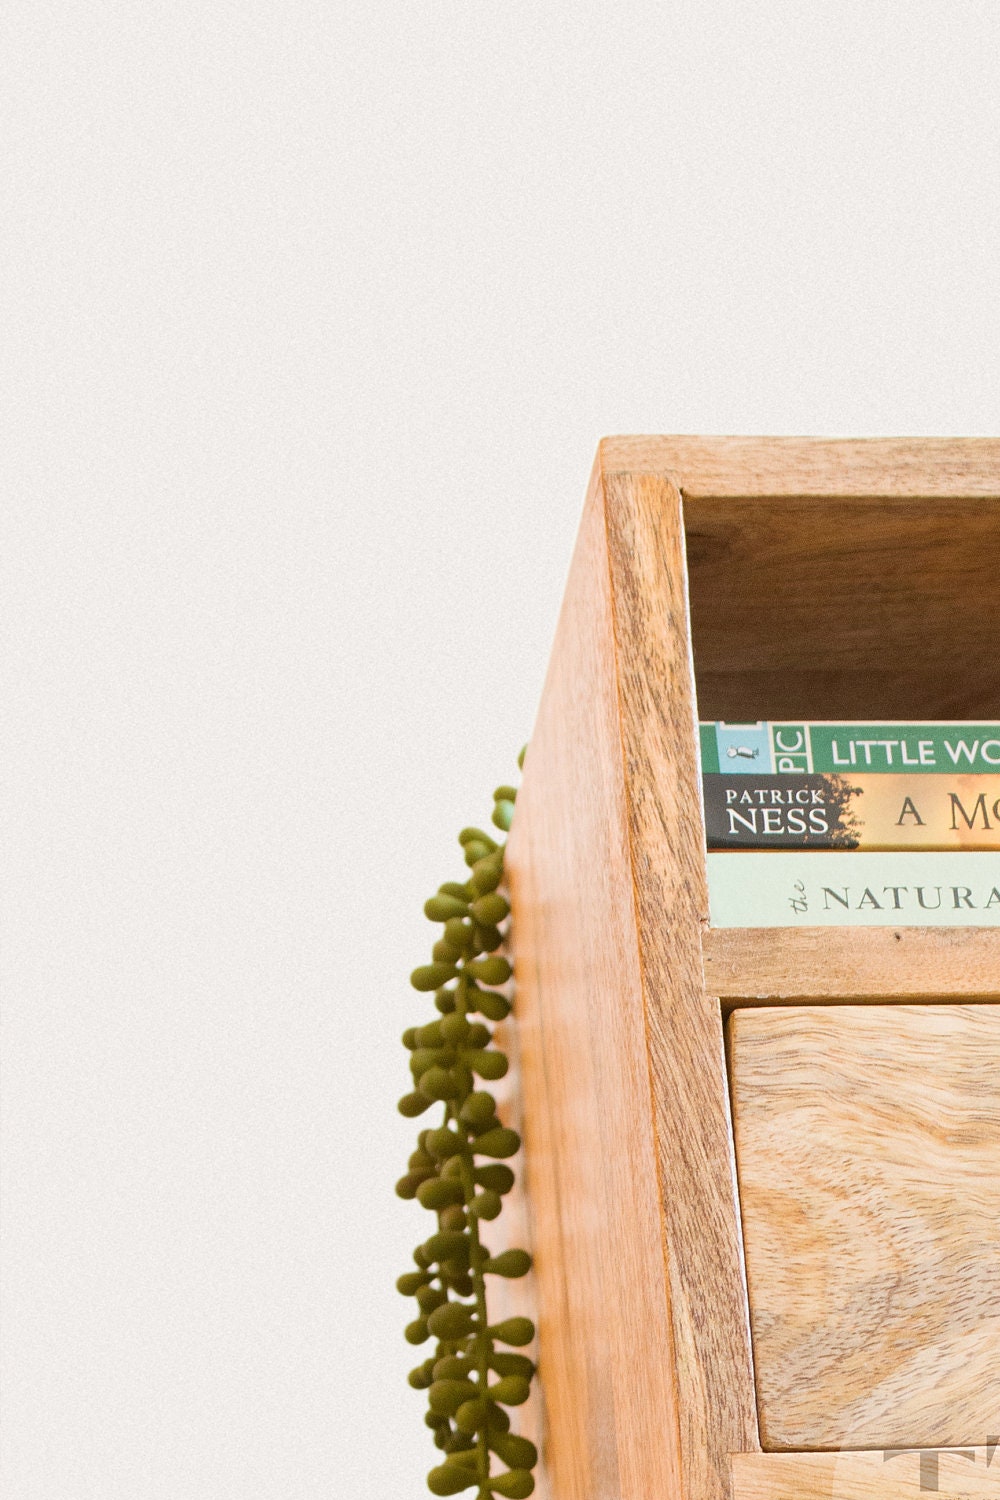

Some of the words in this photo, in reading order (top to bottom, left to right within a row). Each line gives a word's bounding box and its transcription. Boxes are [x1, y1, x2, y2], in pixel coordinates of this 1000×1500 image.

[832, 740, 936, 766] LITTLE
[725, 789, 825, 805] PATRICK
[726, 808, 829, 835] NESS
[895, 797, 926, 826] A
[788, 879, 808, 915] the
